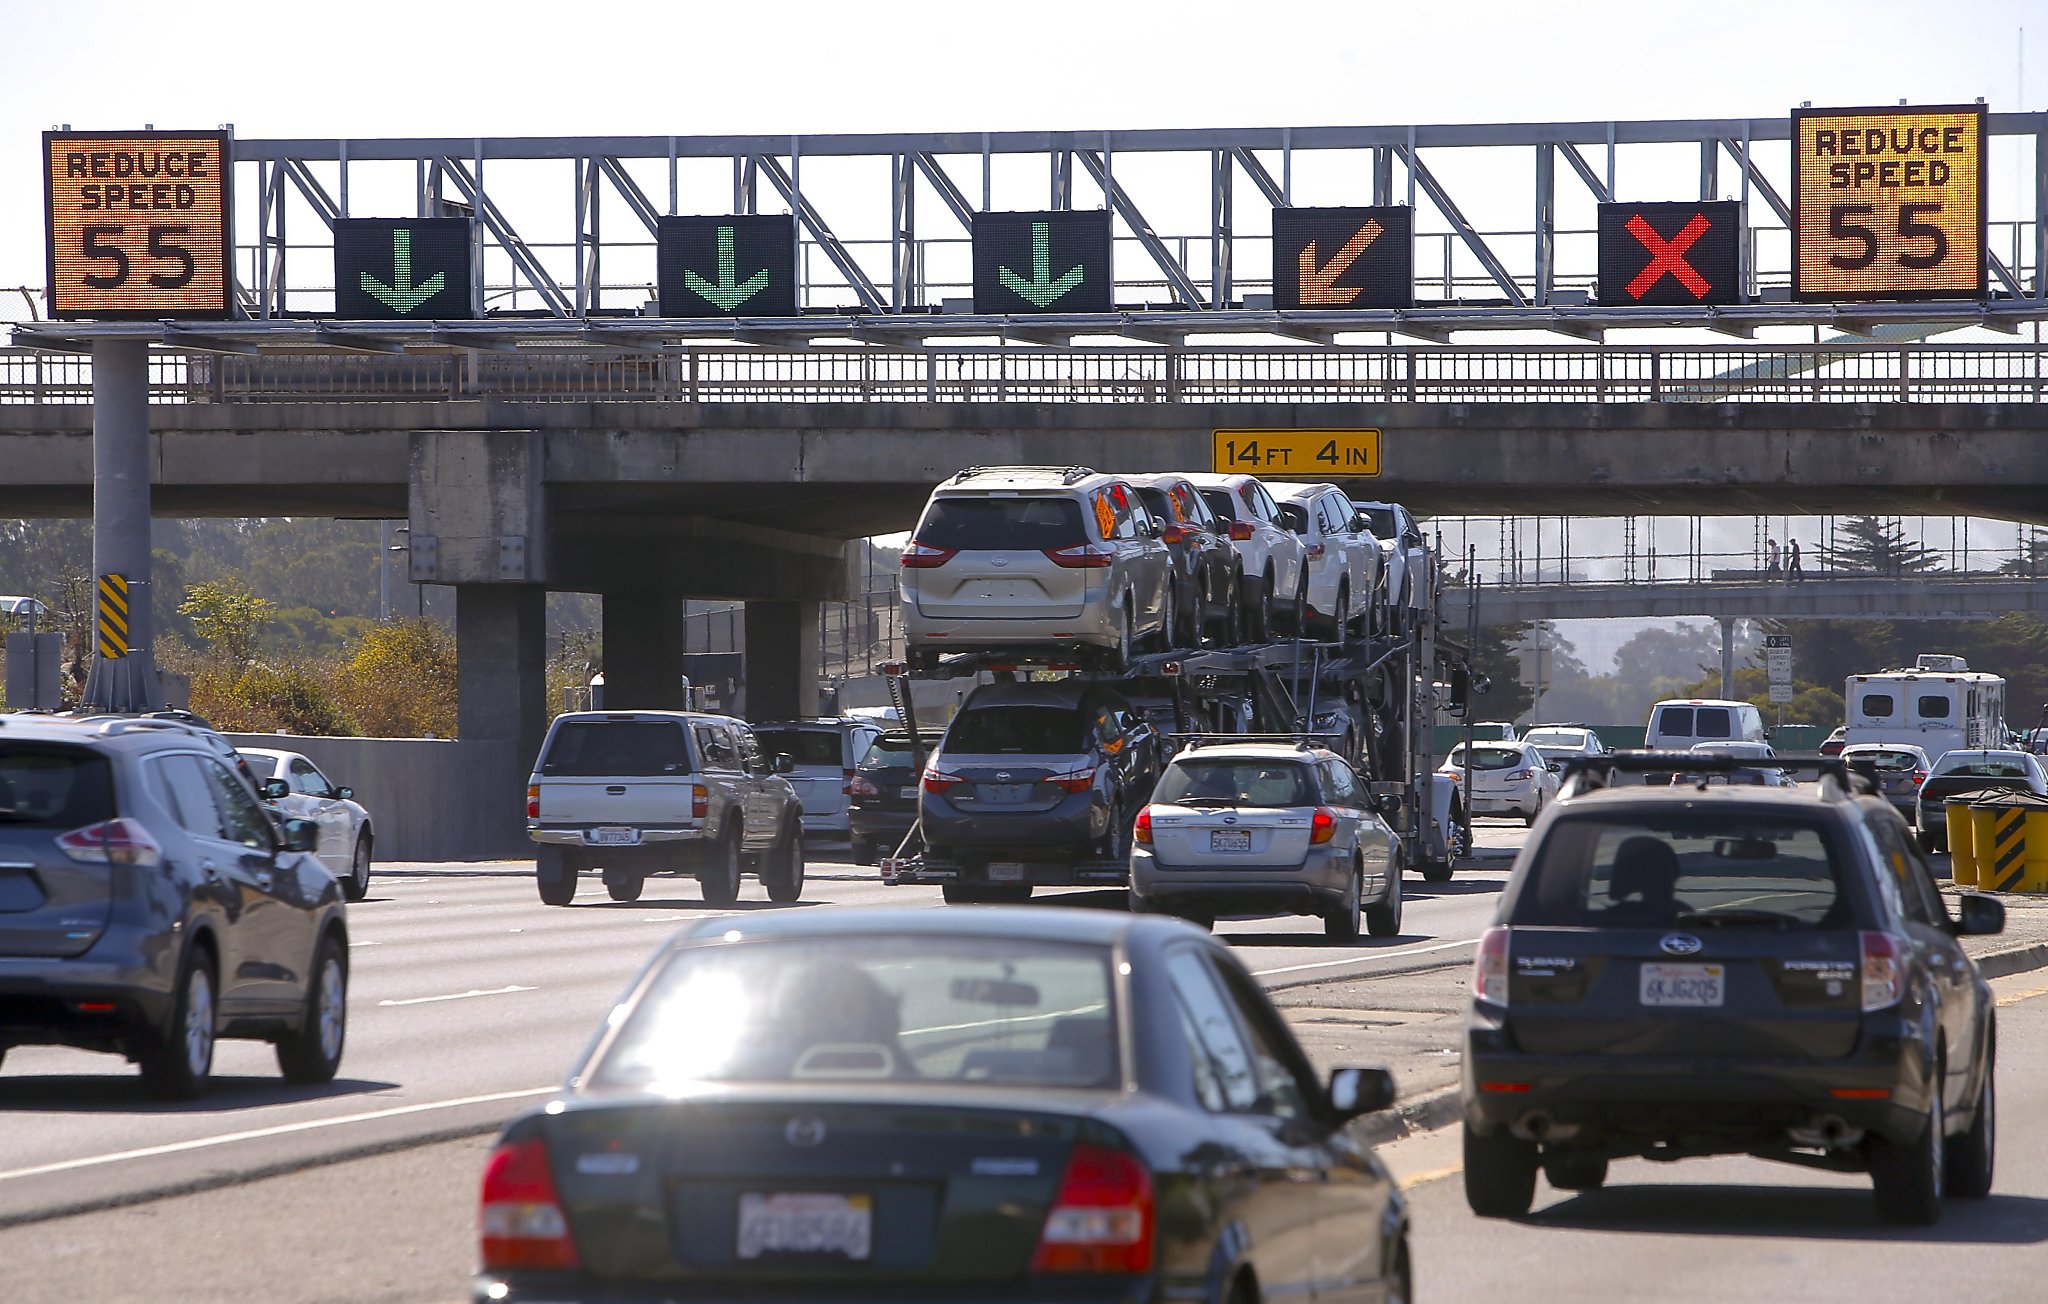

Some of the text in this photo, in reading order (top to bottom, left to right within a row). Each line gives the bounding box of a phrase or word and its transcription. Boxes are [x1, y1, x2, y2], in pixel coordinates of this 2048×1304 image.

[1816, 127, 1964, 156] REDUCE
[67, 152, 207, 178] REDUCE
[1829, 160, 1950, 189] SPEED
[80, 184, 195, 210] SPEED
[1829, 203, 1948, 270] 55
[82, 226, 195, 289] 55
[1226, 439, 1368, 466] 14 FT 4 IN
